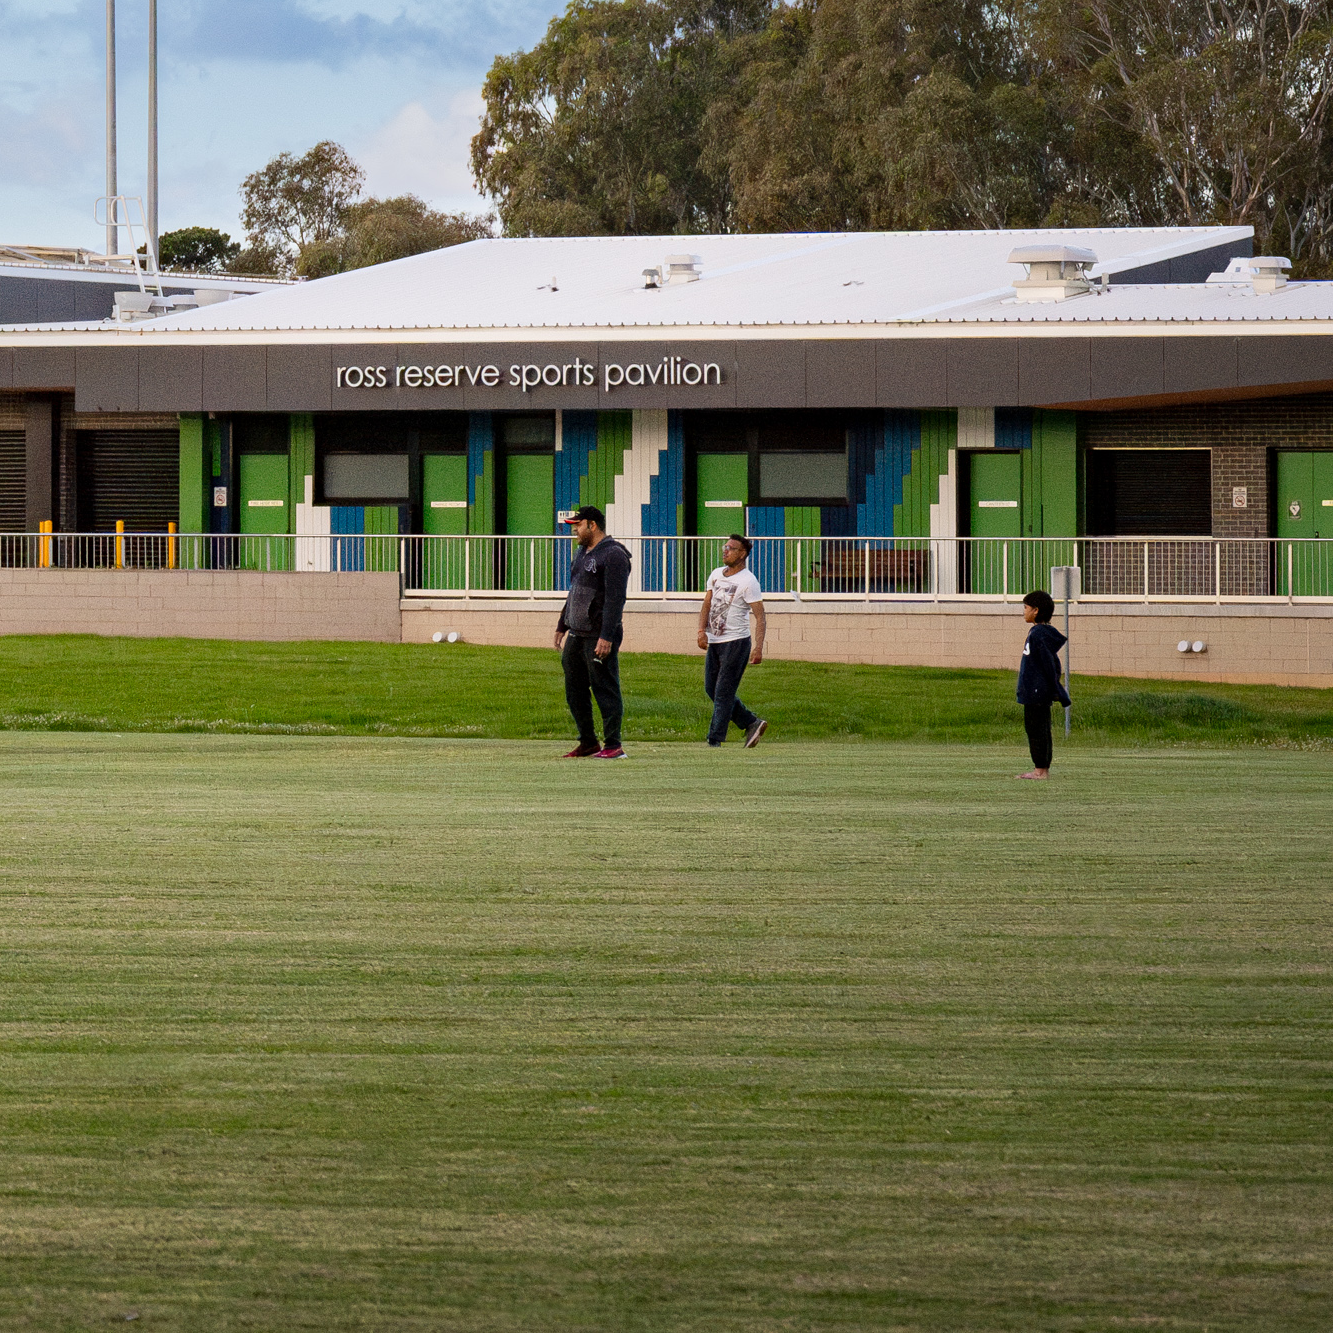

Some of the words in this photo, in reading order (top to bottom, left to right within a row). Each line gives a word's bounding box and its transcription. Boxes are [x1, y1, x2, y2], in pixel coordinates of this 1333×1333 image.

[336, 365, 387, 388] ross
[395, 364, 500, 387] reserve
[509, 357, 594, 393] sports
[604, 356, 721, 393] pavilion
